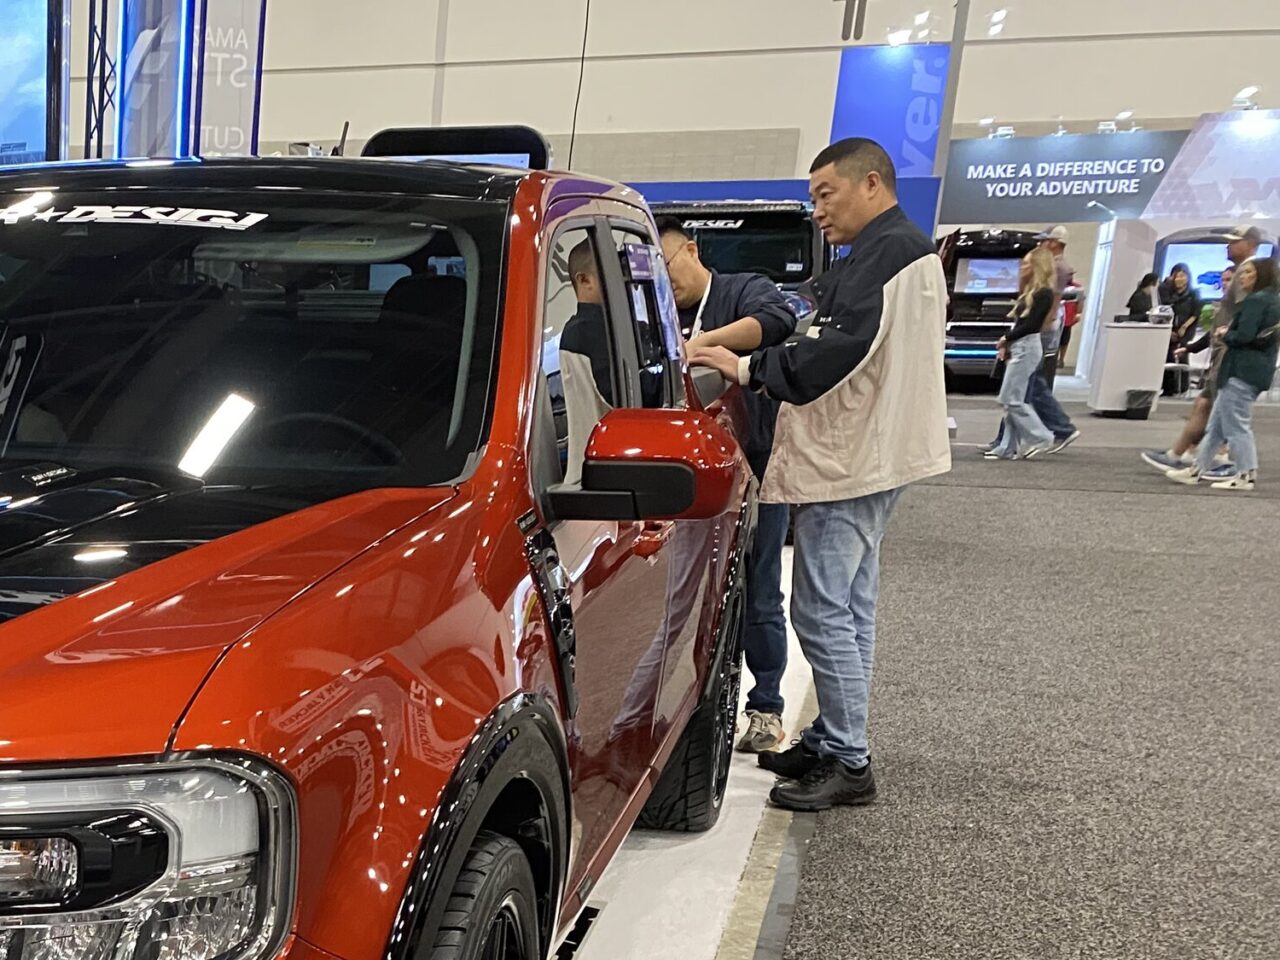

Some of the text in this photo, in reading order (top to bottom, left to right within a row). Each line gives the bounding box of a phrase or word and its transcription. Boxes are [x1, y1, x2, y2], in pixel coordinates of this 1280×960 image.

[967, 158, 1166, 180] MAKE A DIFFERENCE TO
[985, 180, 1033, 198] YOUR
[1035, 178, 1140, 196] ADVENTURE
[57, 205, 270, 231] DESIGN
[682, 219, 745, 229] DESIGN
